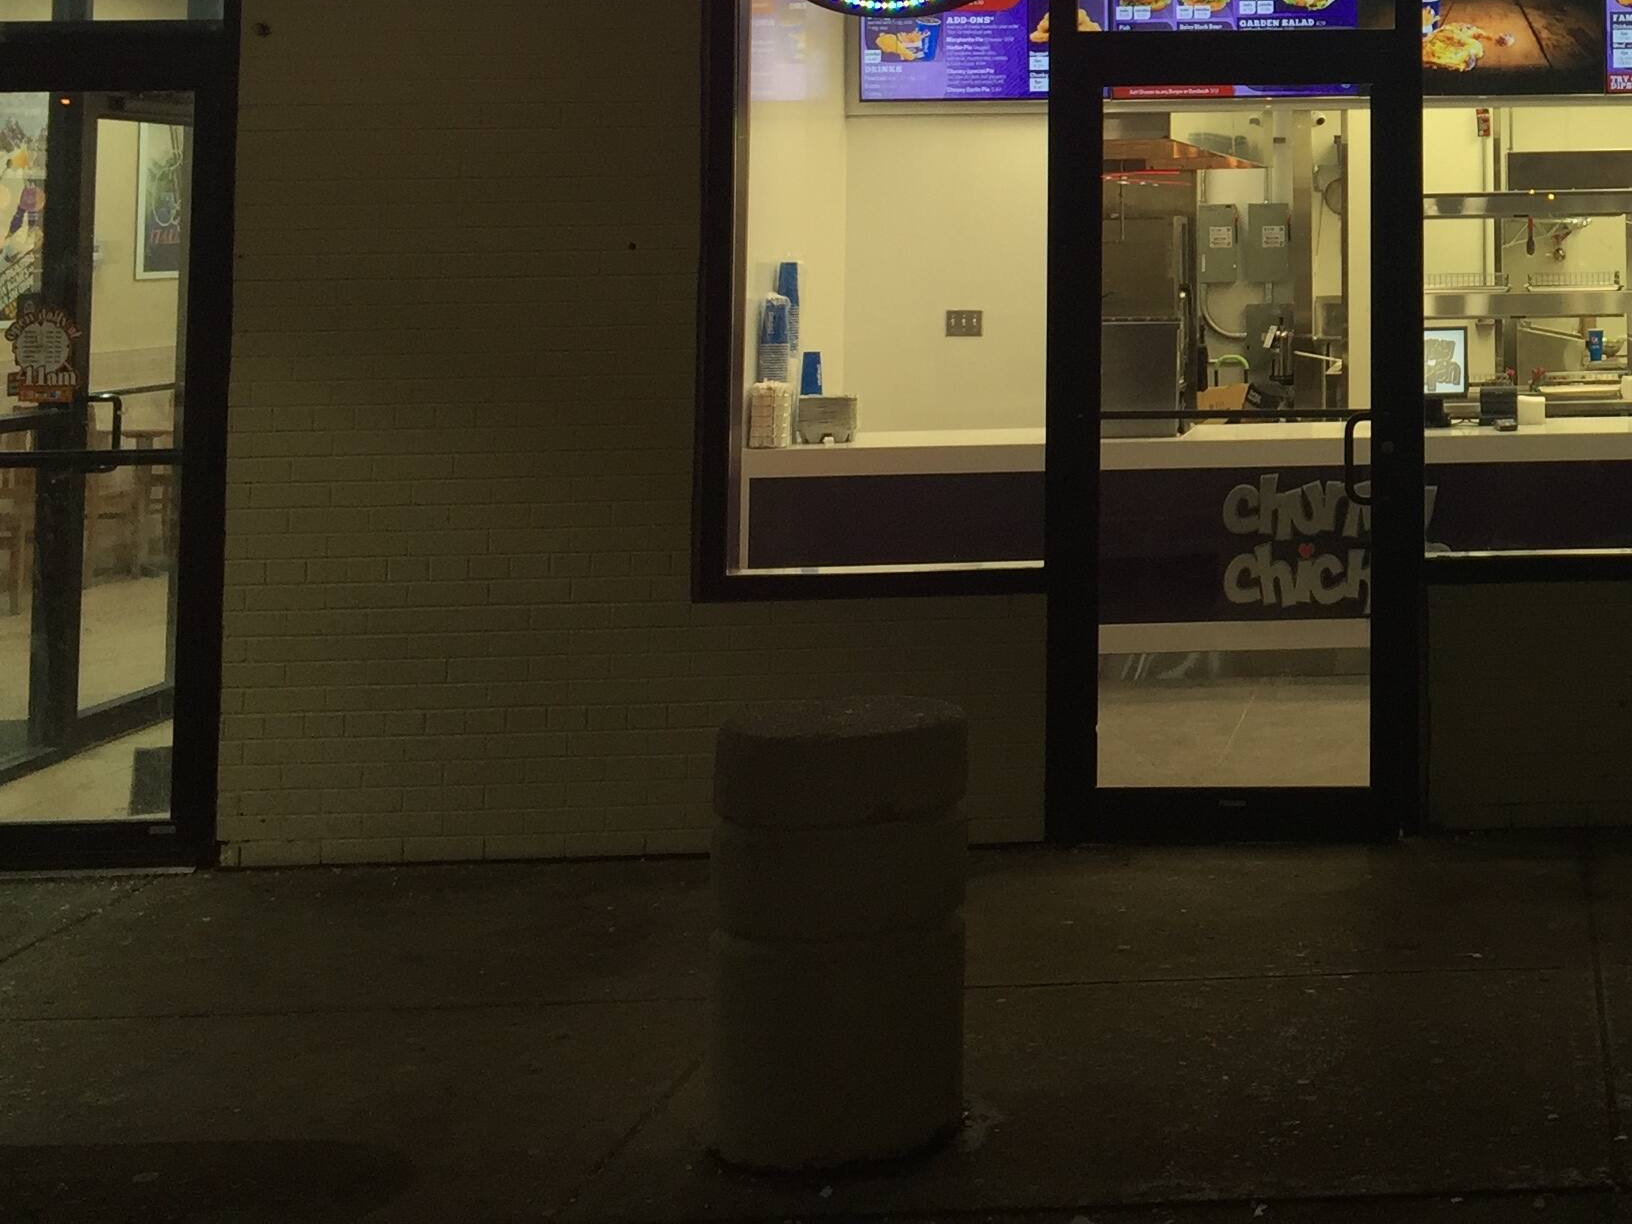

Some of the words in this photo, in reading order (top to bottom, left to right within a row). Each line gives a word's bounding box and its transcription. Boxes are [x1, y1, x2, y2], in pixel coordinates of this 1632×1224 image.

[1239, 19, 1280, 27] GARDEN
[1281, 18, 1315, 27] SALAD
[1223, 473, 1451, 552] chun
[1223, 542, 1371, 614] chic
